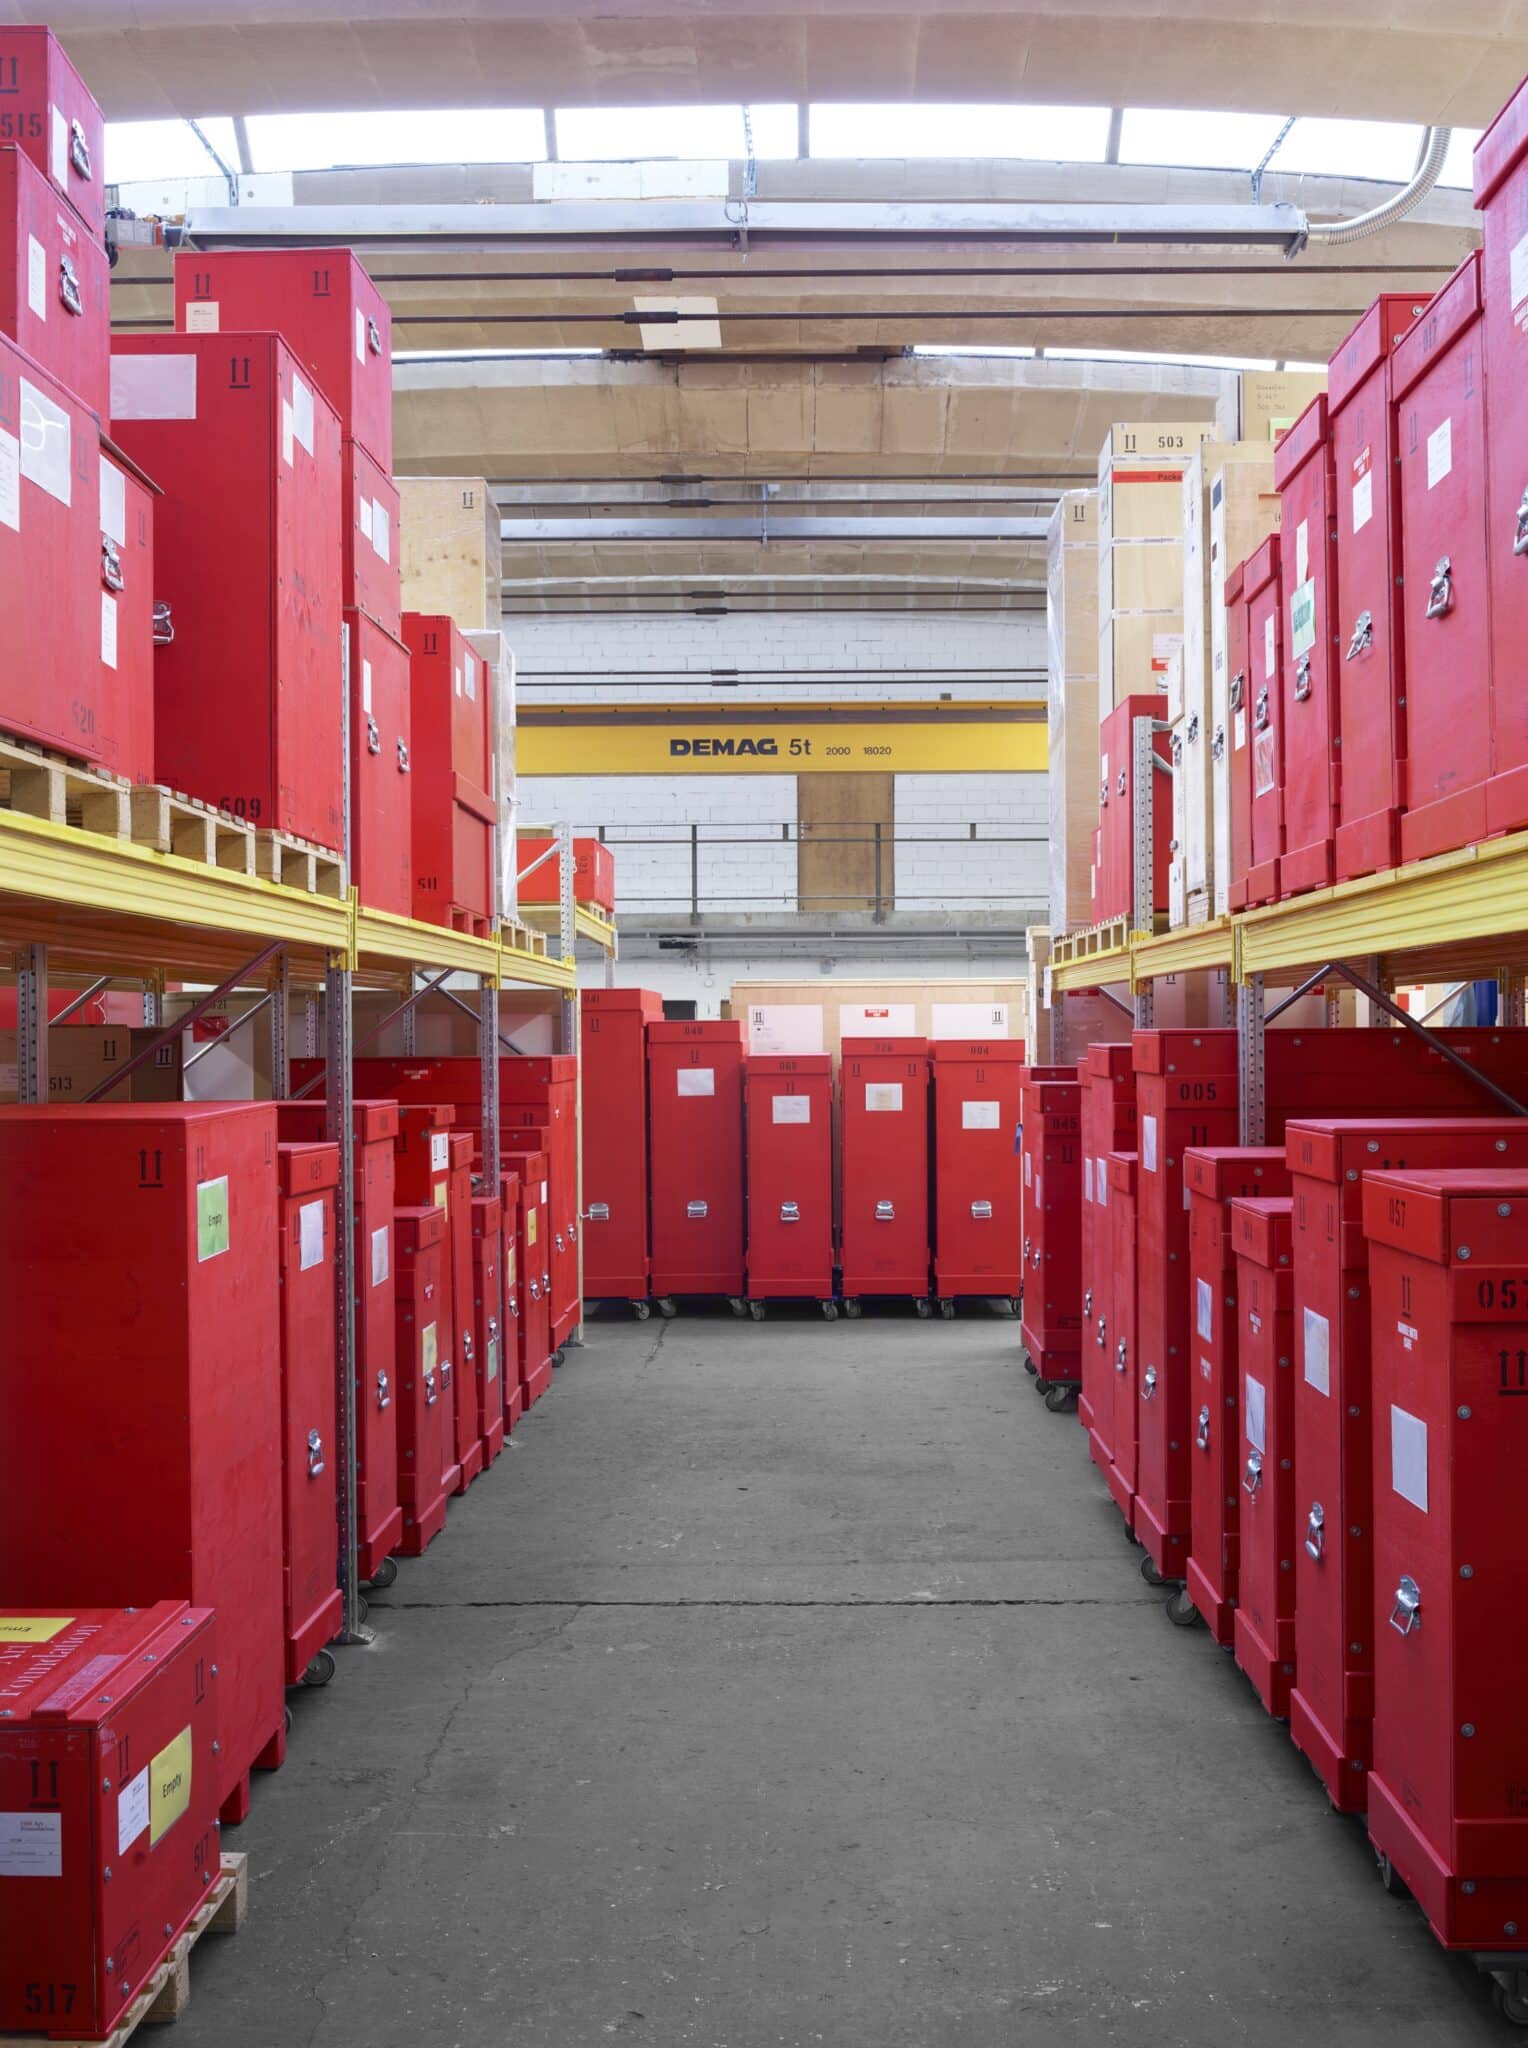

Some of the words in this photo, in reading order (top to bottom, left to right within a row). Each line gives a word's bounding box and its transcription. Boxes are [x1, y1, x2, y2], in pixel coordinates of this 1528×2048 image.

[1, 113, 42, 137] 515
[1158, 436, 1184, 448] 503
[670, 739, 778, 756] DEMAG
[789, 738, 812, 756] 5t
[826, 746, 851, 756] 2000
[863, 746, 892, 756] 18020
[49, 1076, 72, 1091] 513
[1180, 1082, 1217, 1101] 005
[1389, 1199, 1406, 1229] 057
[162, 1773, 182, 1798] Empty
[25, 1983, 78, 2016] 517
